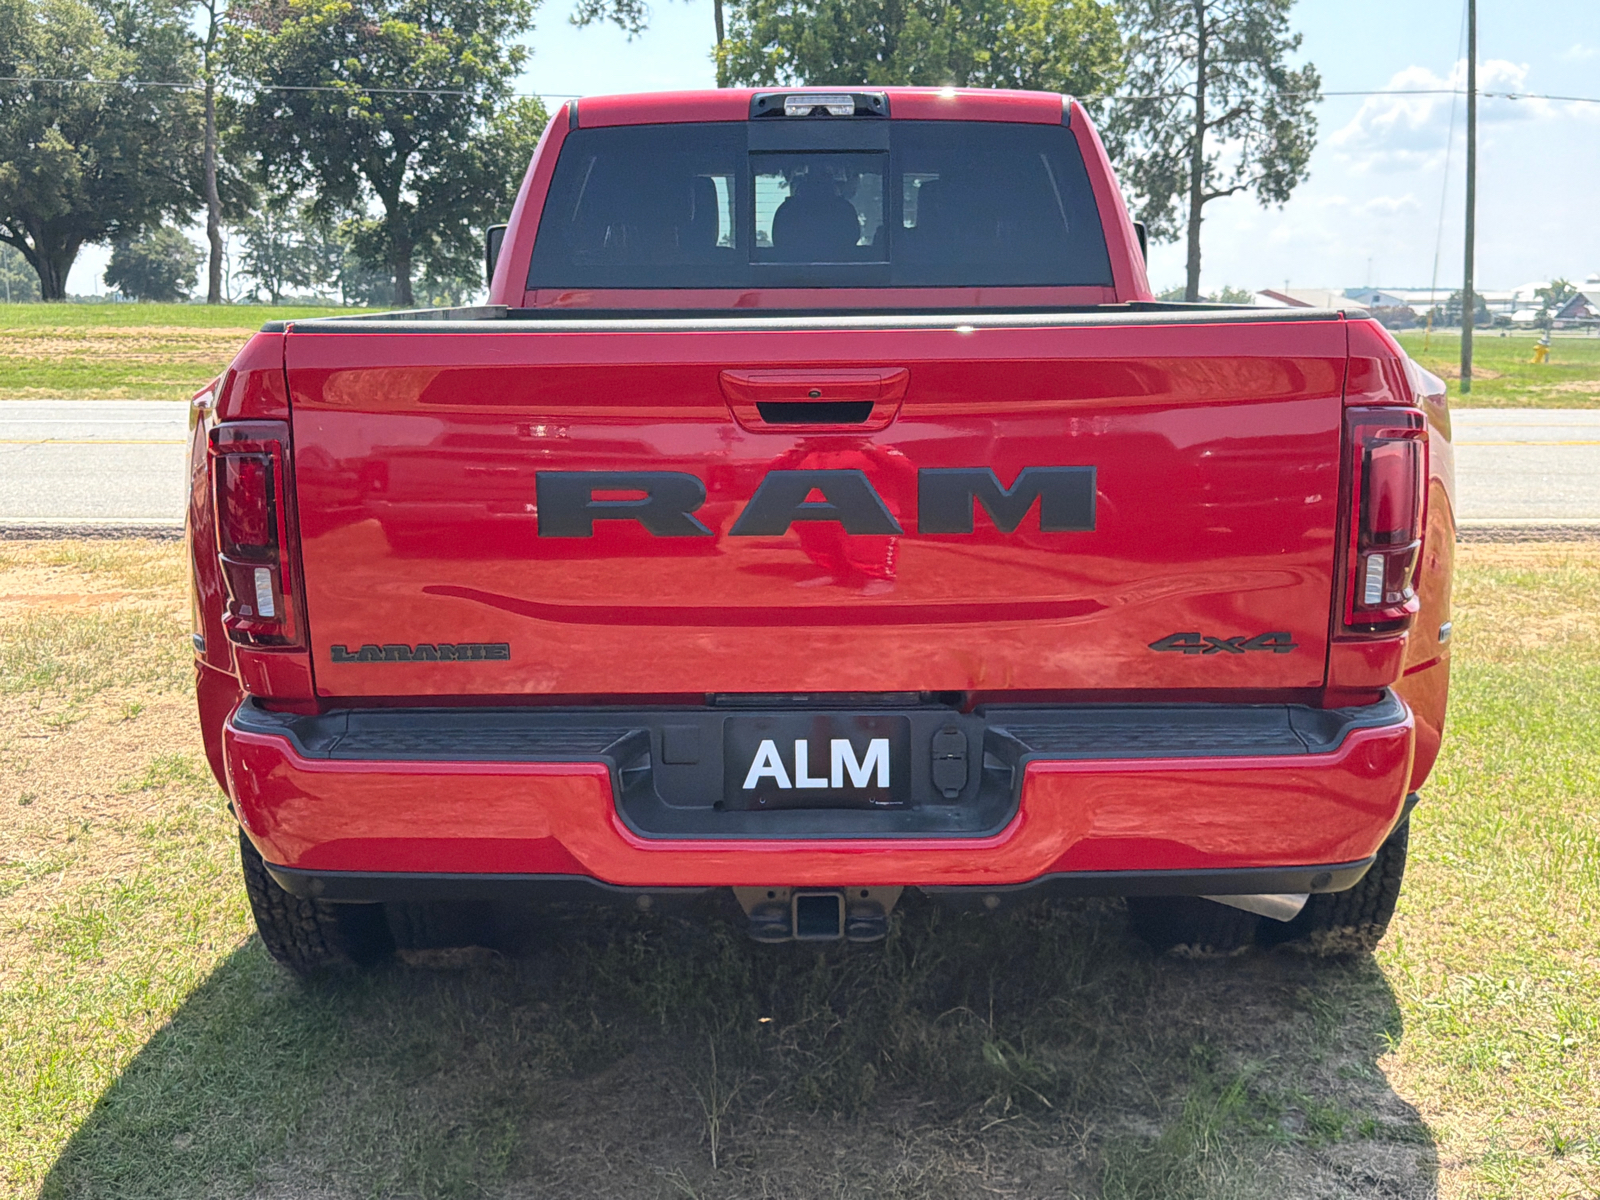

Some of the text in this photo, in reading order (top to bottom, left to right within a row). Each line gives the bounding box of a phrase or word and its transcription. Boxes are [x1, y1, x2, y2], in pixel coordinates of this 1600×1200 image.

[535, 465, 1097, 538] RAM
[330, 643, 510, 663] LARAMIE
[1148, 631, 1299, 655] 4x4
[742, 738, 891, 790] ALM
